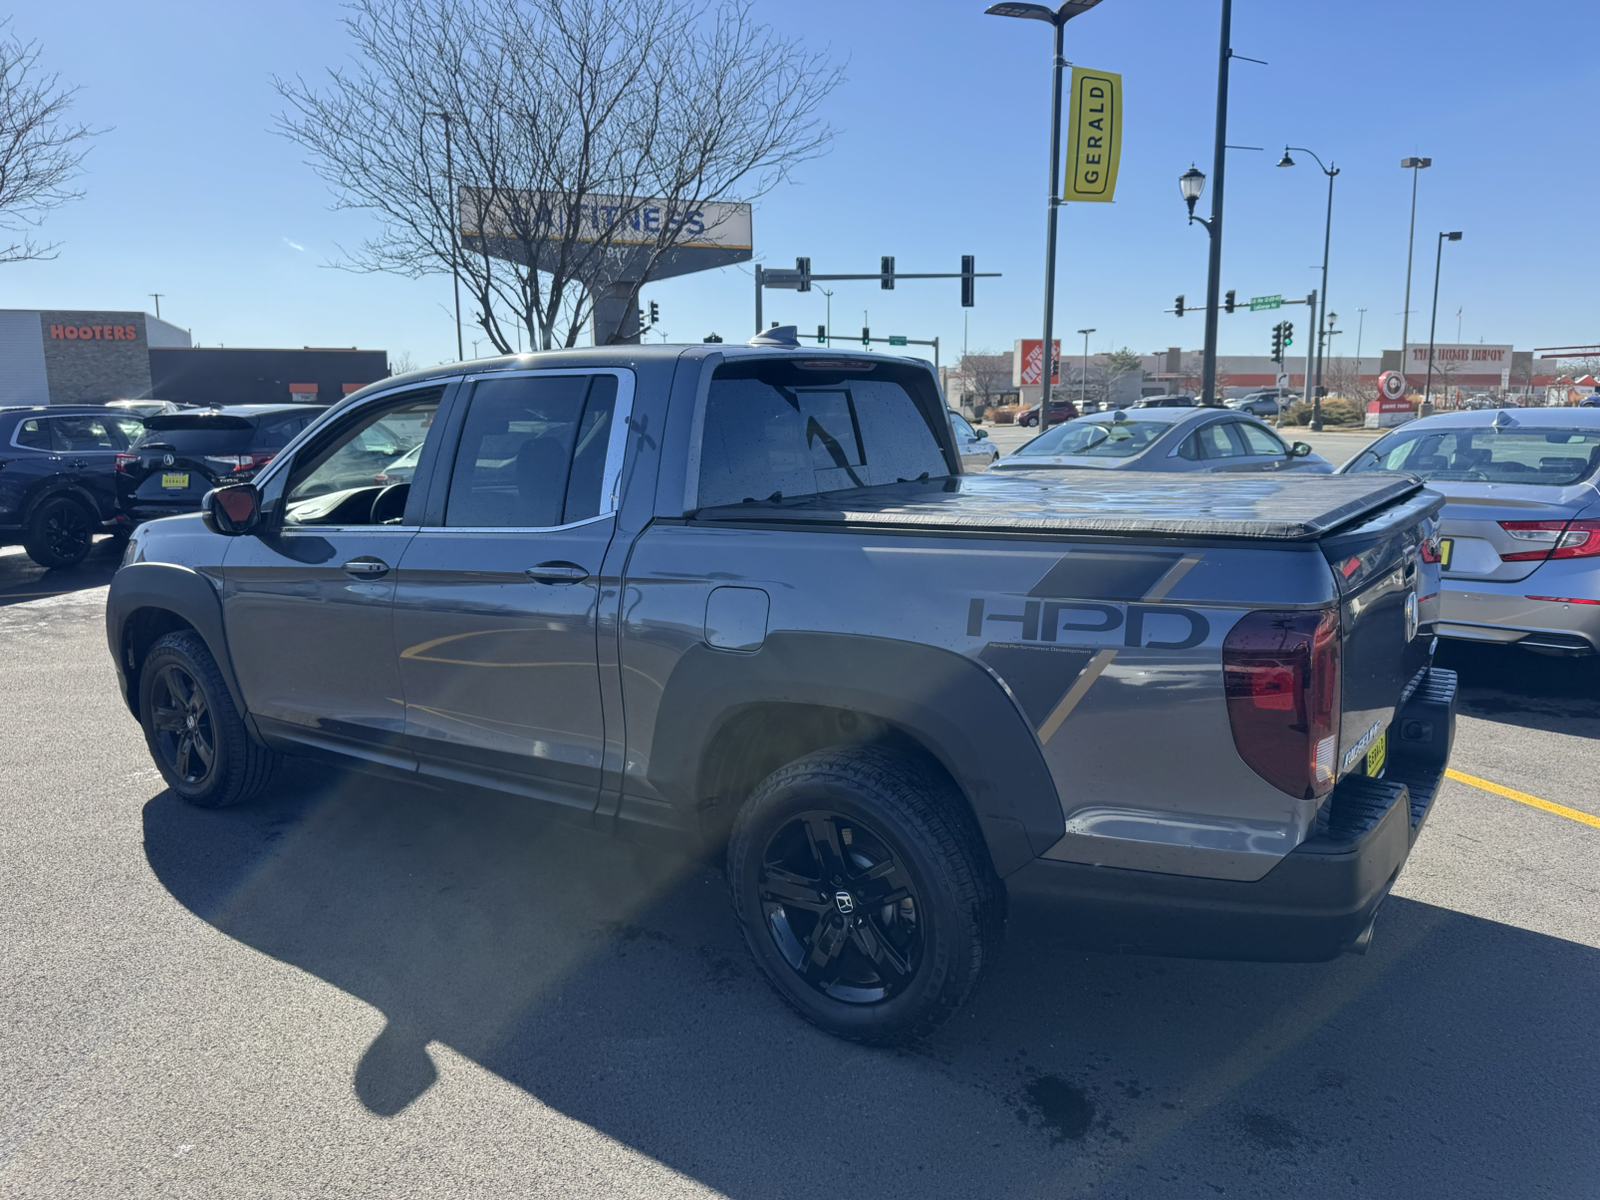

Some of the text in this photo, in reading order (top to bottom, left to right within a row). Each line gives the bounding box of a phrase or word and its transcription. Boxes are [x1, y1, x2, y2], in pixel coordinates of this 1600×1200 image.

[1084, 87, 1105, 184] GERALD
[50, 324, 137, 340] HOOTERS
[1413, 348, 1505, 361] THE HOME DEPOT
[966, 597, 1211, 650] HPD
[1009, 643, 1050, 652] Performance
[1050, 646, 1093, 655] Development
